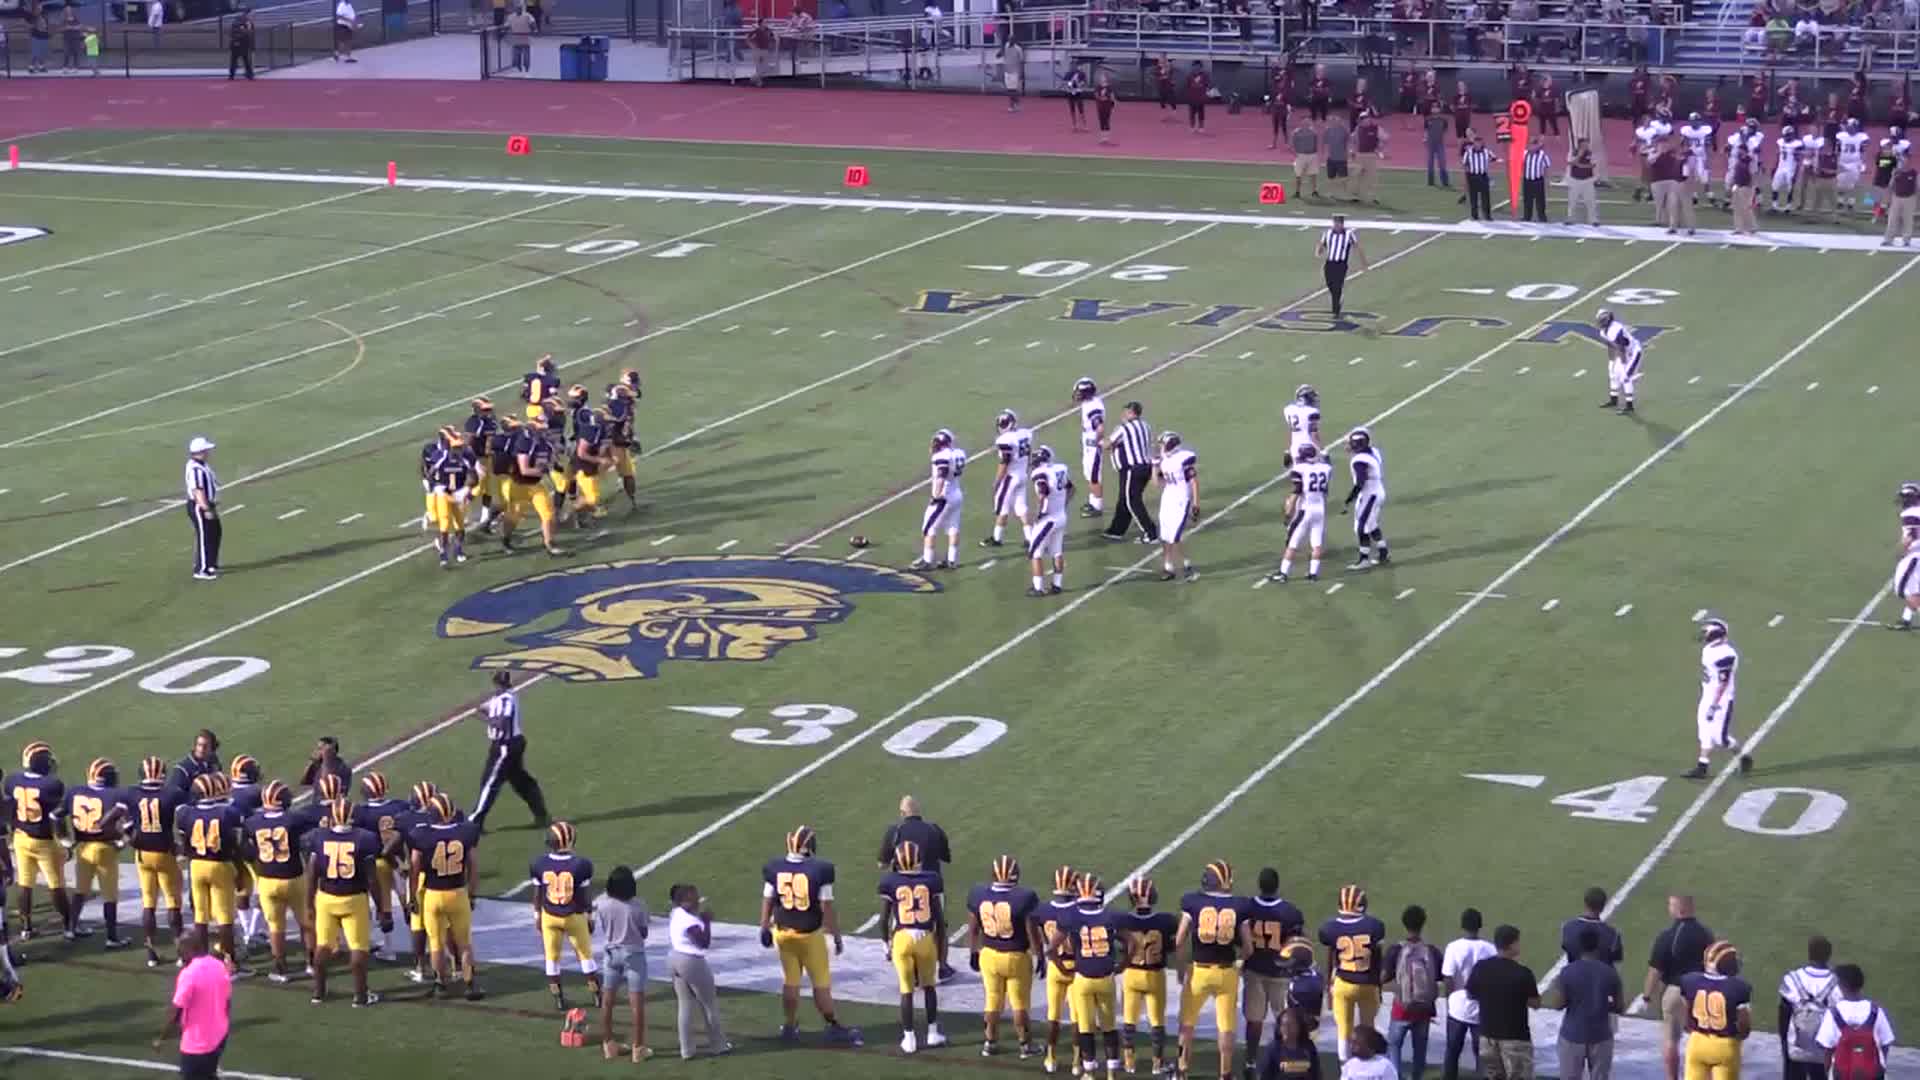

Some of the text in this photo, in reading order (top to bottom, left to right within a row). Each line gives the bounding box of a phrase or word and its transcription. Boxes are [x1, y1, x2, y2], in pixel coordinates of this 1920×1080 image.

[848, 169, 862, 183] 10
[1262, 185, 1279, 200] 20
[1505, 283, 1681, 306] 30
[1308, 471, 1329, 493] 22
[730, 703, 1009, 760] 30
[72, 794, 104, 834] 52
[138, 797, 163, 834] 11
[1549, 775, 1849, 836] 40
[190, 818, 221, 856] 44
[255, 826, 291, 864] 53
[322, 840, 355, 879] 75
[431, 839, 465, 877] 42
[895, 884, 932, 925] 23
[1336, 933, 1372, 973] 25
